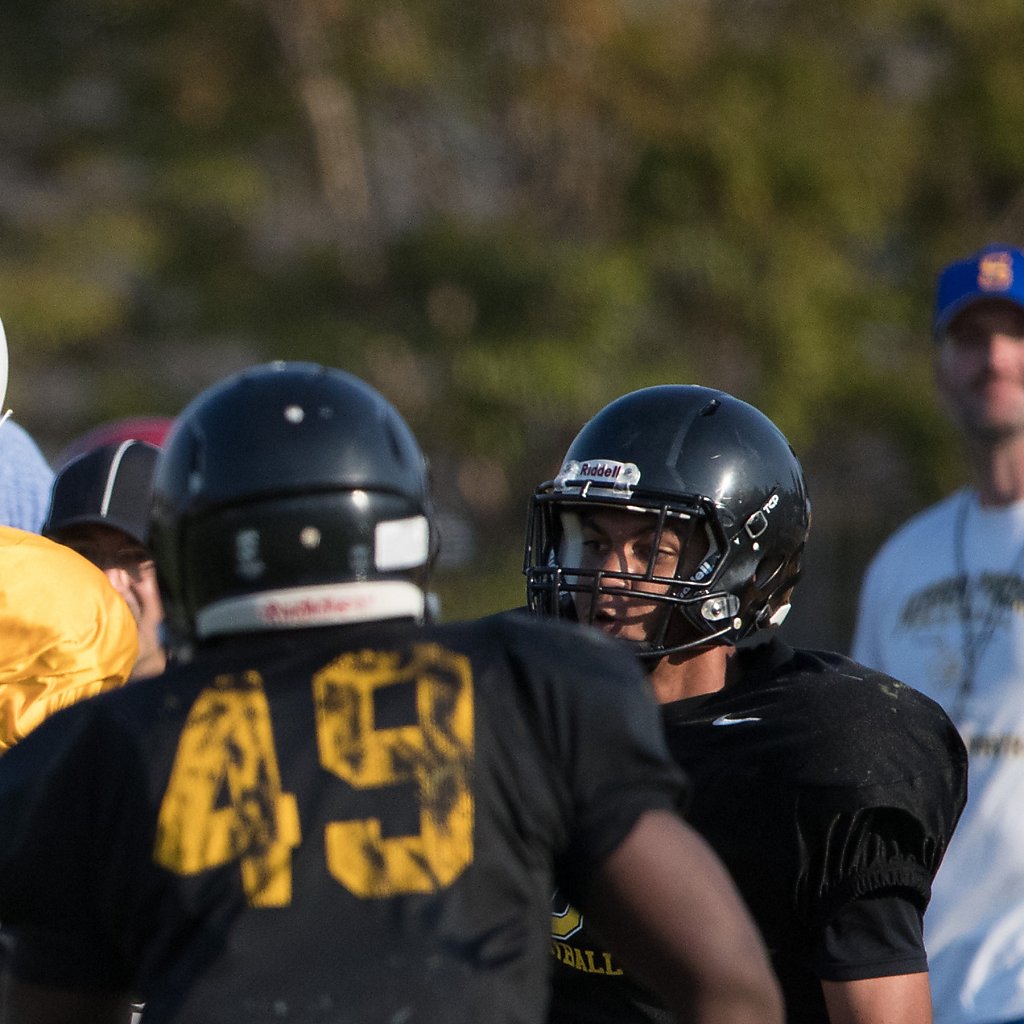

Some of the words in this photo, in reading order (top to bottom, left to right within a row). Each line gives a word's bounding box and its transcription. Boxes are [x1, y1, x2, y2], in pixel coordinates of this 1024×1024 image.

[580, 463, 621, 478] Riddell
[763, 495, 779, 513] TCP
[153, 643, 474, 907] 49
